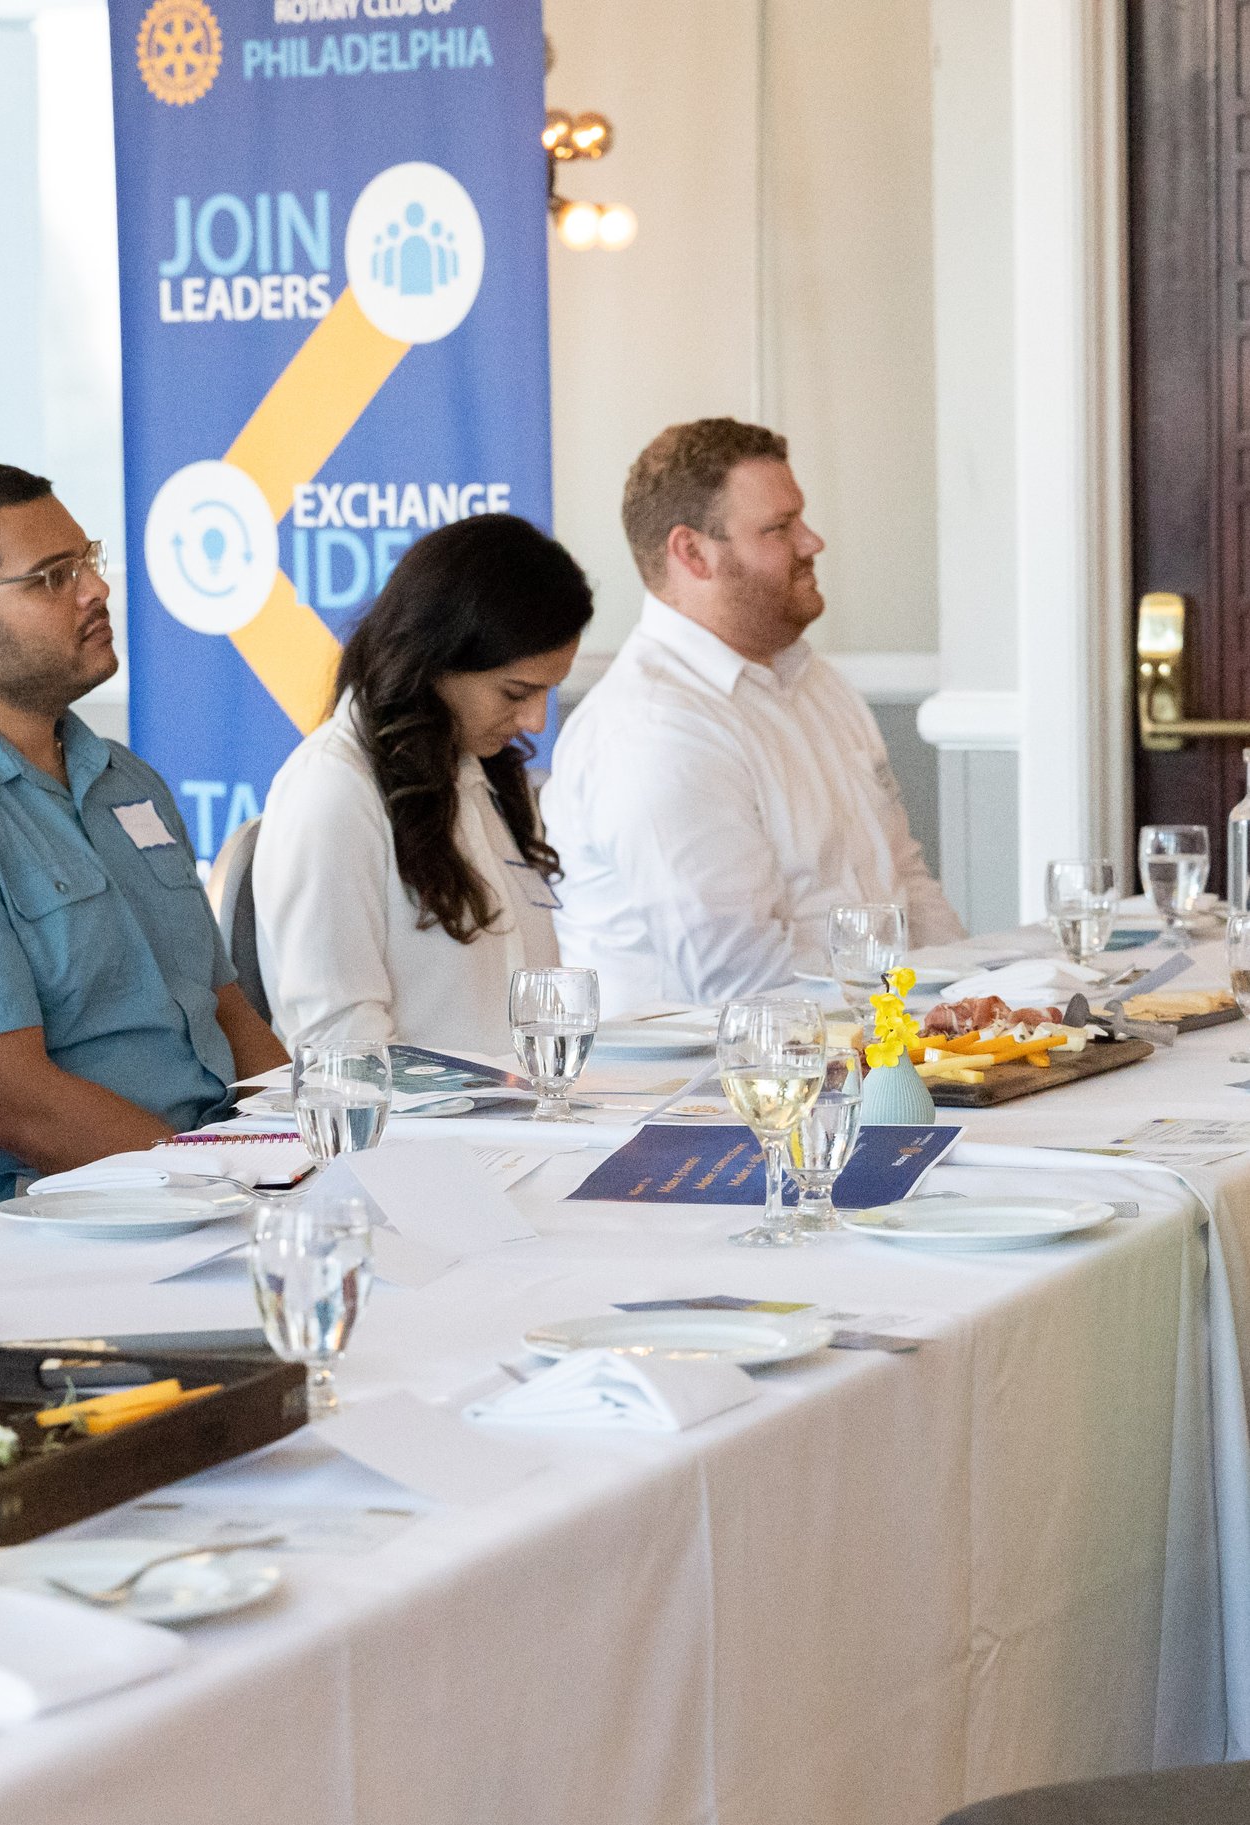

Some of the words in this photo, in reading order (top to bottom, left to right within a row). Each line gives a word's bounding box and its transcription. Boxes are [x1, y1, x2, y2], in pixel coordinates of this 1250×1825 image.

[243, 26, 493, 79] PHILADELPHIA
[158, 189, 332, 278] JOIN
[159, 273, 332, 324] LEADERS
[292, 482, 511, 529] EXCHANGE
[292, 528, 414, 609] IDE
[179, 779, 259, 859] TA
